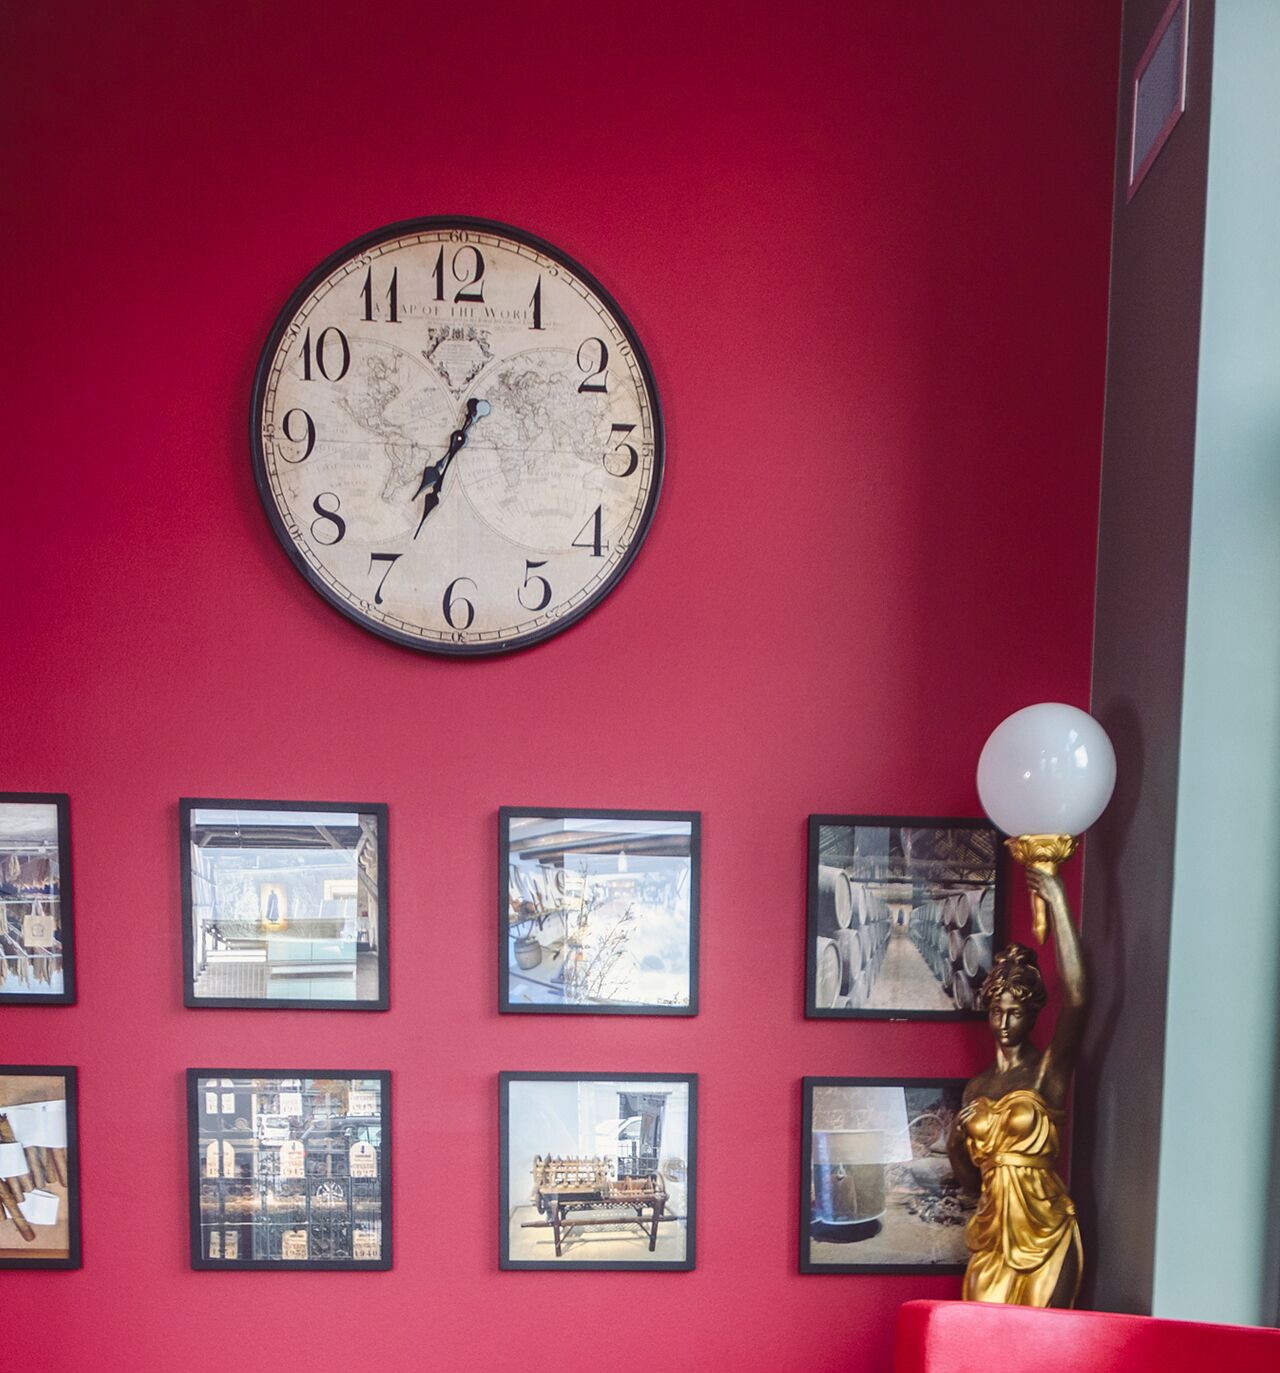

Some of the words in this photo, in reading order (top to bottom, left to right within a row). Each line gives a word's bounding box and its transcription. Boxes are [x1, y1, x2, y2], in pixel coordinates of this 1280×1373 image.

[449, 230, 469, 243] 60
[359, 265, 402, 324] 11
[431, 244, 486, 304] 12
[528, 273, 547, 331] 1
[298, 326, 351, 383] 10
[576, 336, 609, 394] 2
[277, 407, 316, 464] 9
[602, 423, 639, 478] 3
[309, 491, 347, 546] 8
[571, 503, 610, 558] 4
[367, 552, 404, 605] 7
[442, 576, 479, 630] 6
[517, 558, 552, 612] 5
